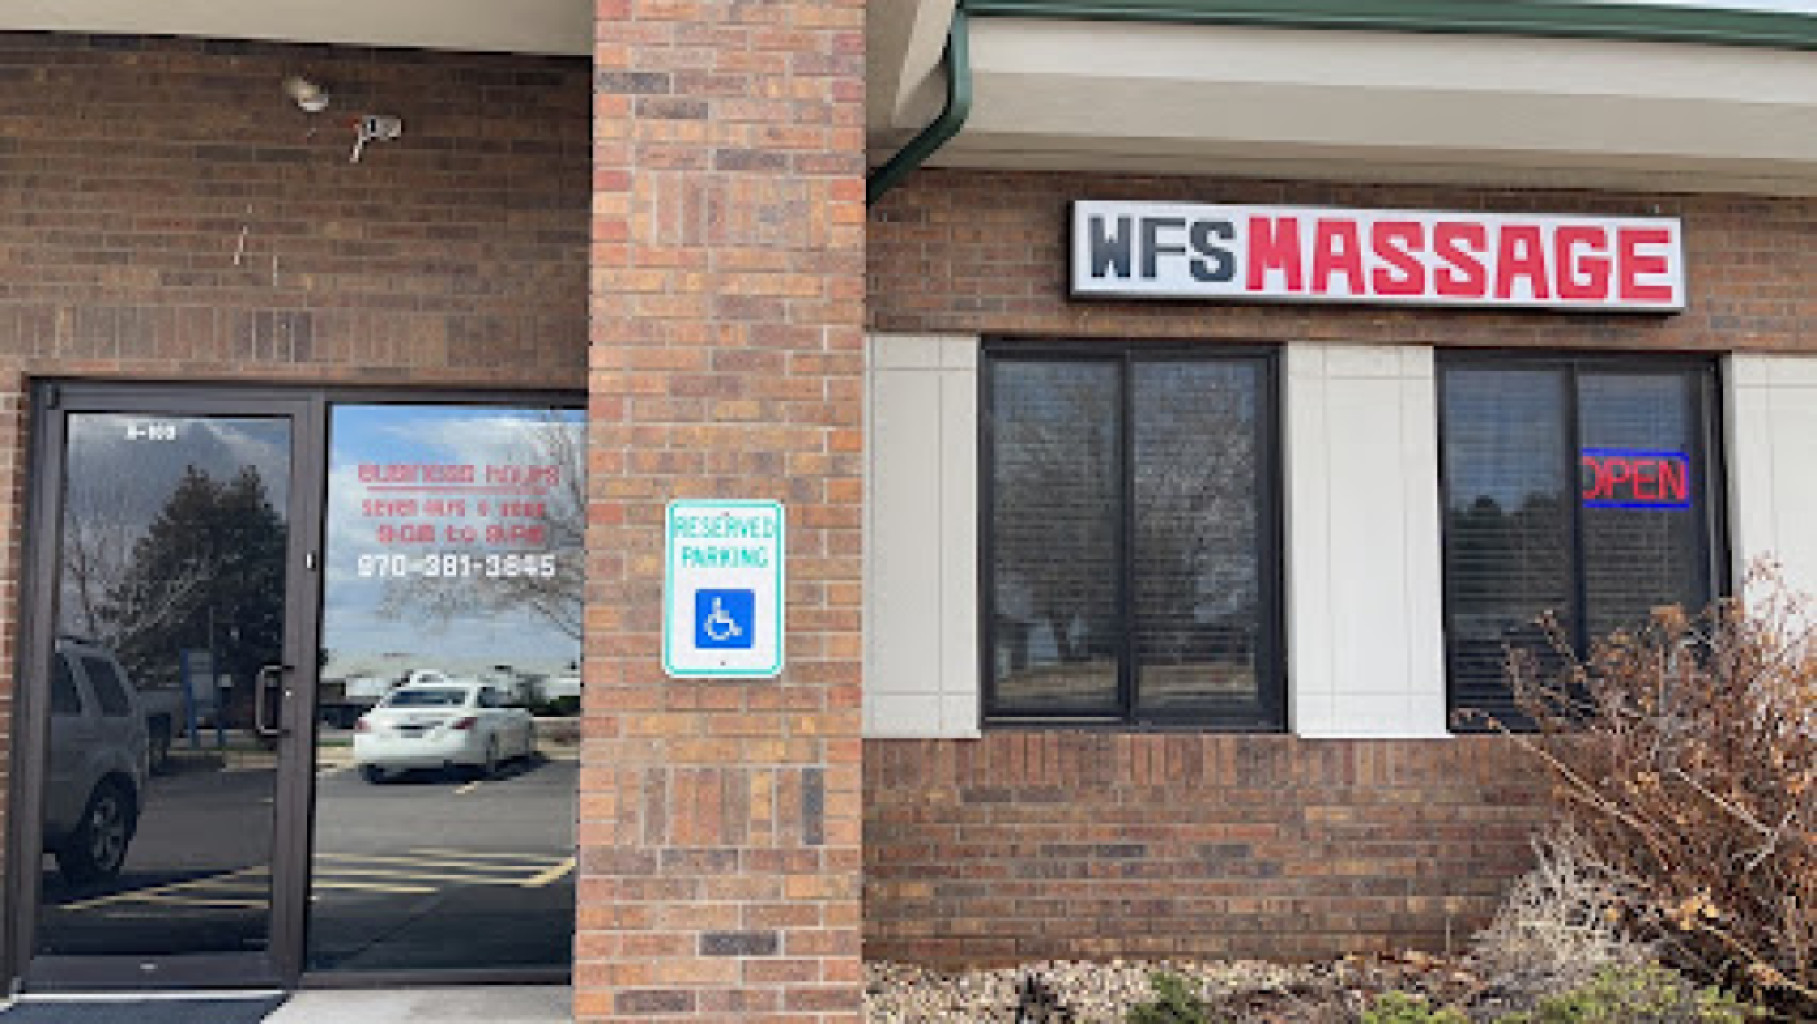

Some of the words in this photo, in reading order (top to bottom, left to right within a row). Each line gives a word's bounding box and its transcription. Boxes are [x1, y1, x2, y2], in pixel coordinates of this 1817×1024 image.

[1088, 212, 1236, 283] WFS
[1245, 215, 1673, 303] MASSAGE
[1582, 456, 1685, 499] OPEN
[674, 515, 775, 538] RESERVED
[682, 545, 769, 568] PARKING
